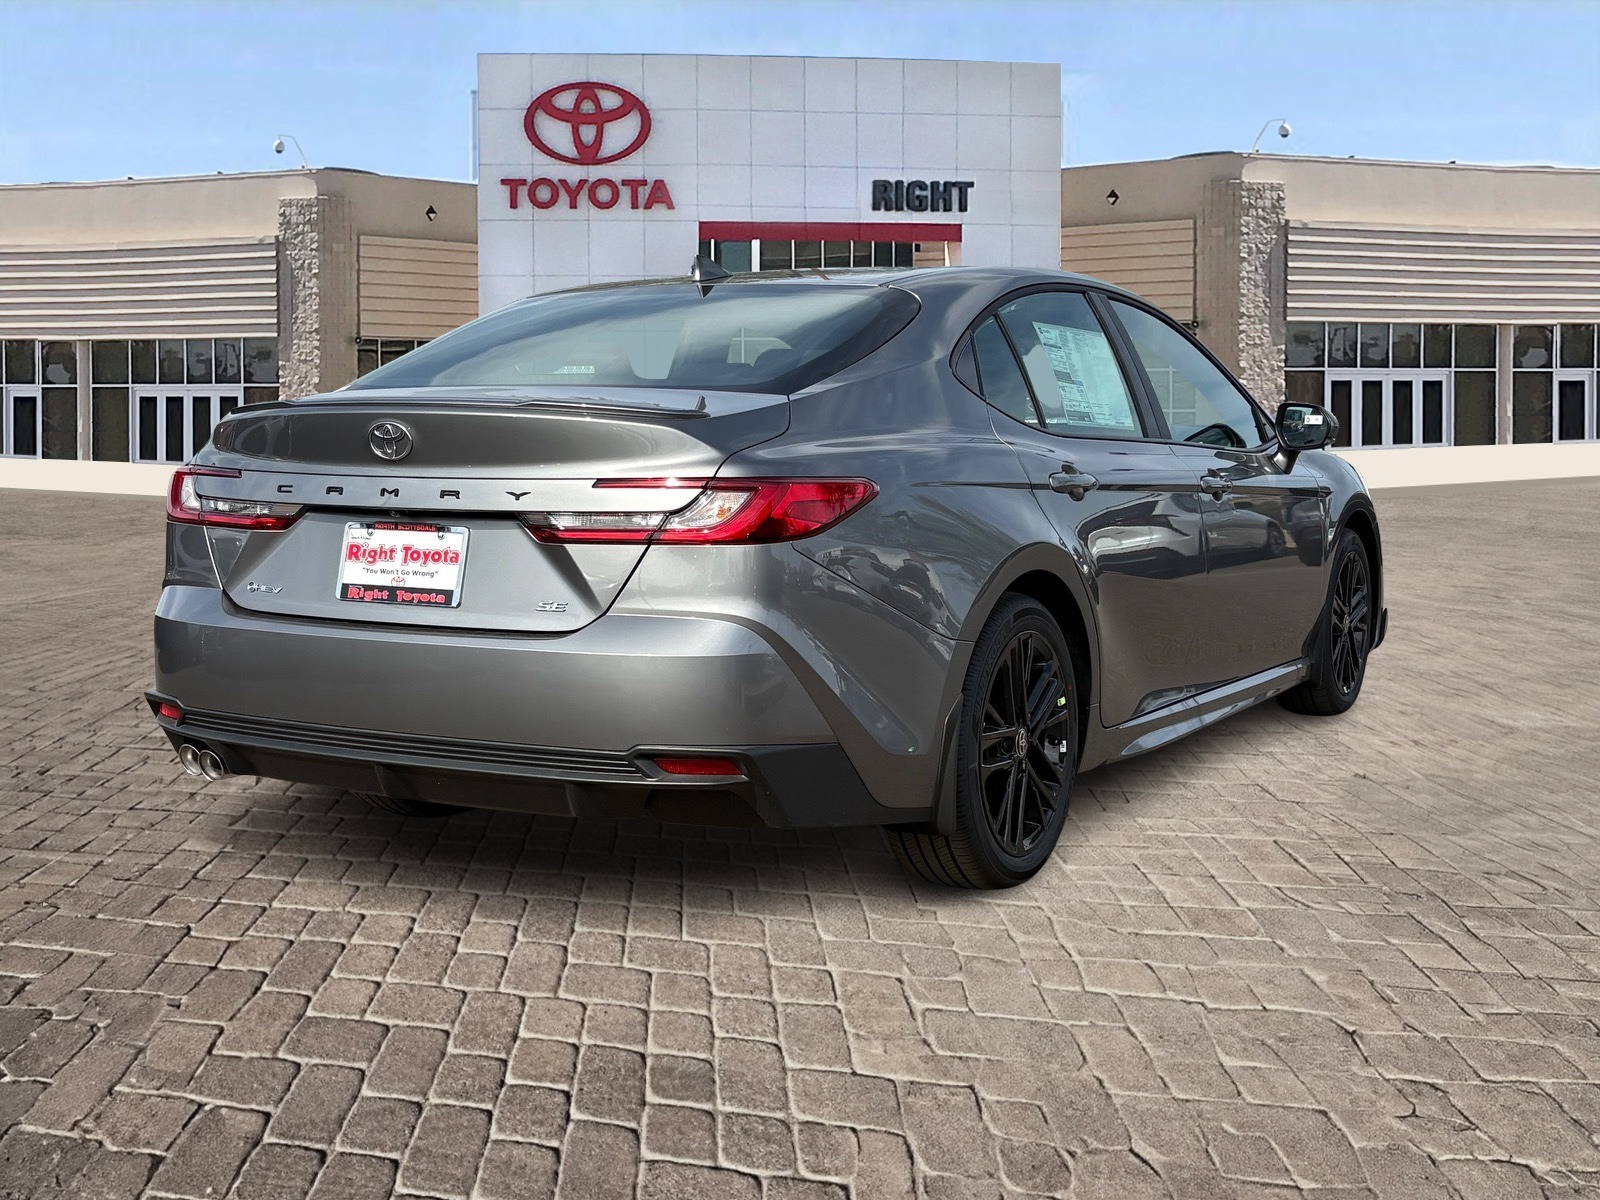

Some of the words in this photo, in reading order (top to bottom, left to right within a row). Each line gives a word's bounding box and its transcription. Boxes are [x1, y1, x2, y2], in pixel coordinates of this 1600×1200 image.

[501, 179, 675, 210] TOYOTA
[871, 179, 975, 213] RIGHT
[277, 484, 532, 501] CAMRY
[346, 542, 397, 565] Right
[401, 544, 461, 567] Toyota
[347, 586, 390, 602] Right
[396, 589, 446, 604] Toyota
[535, 600, 569, 613] SE
